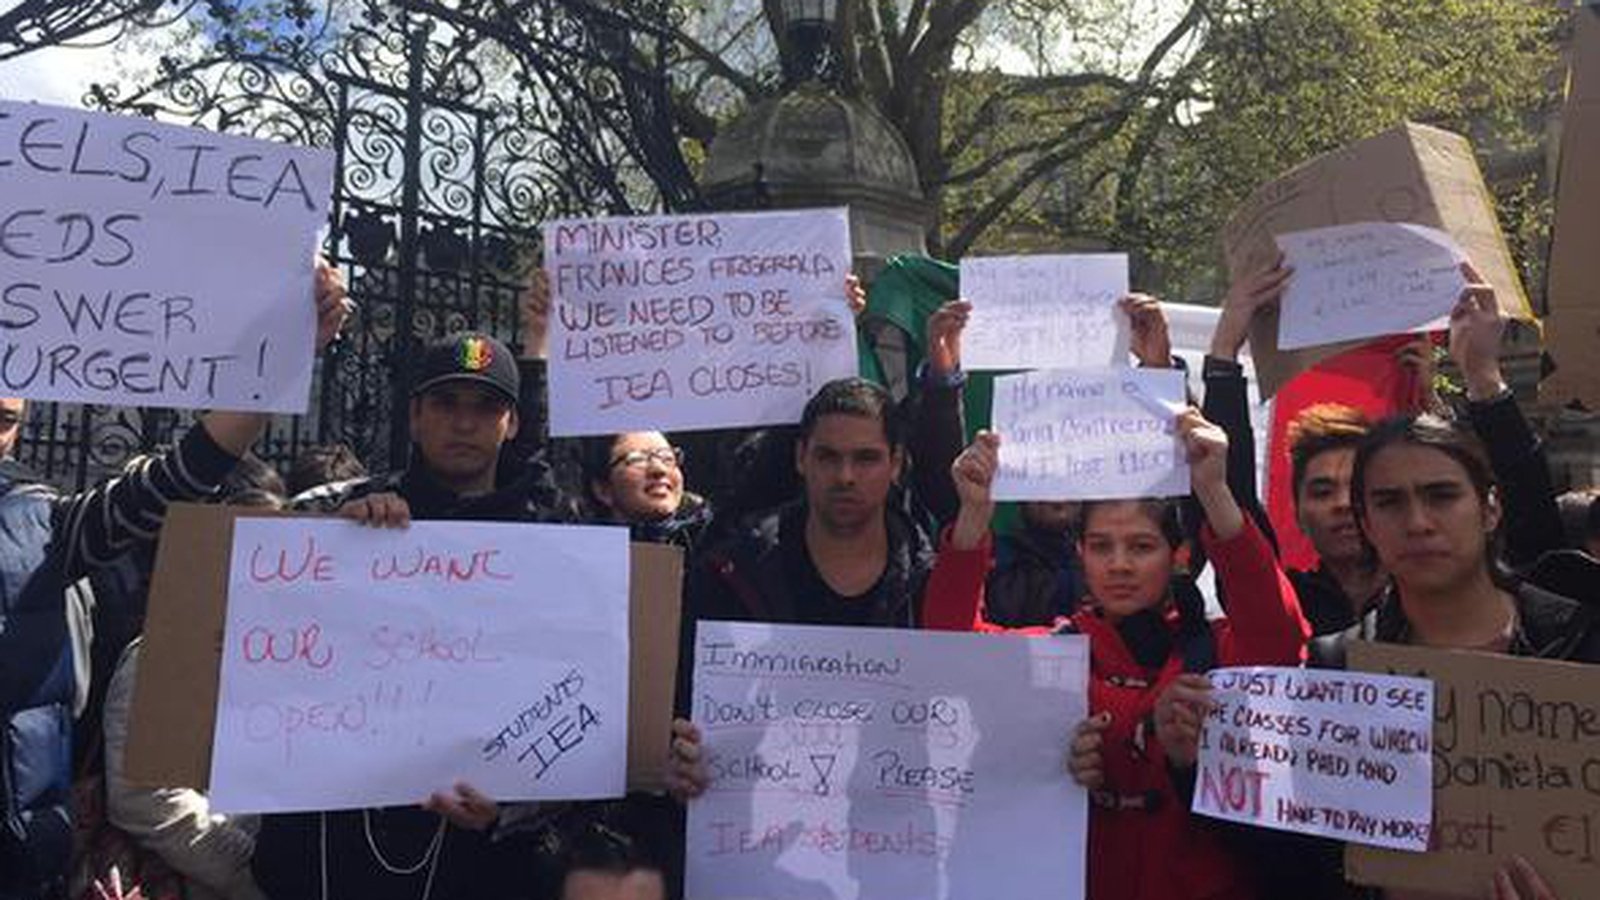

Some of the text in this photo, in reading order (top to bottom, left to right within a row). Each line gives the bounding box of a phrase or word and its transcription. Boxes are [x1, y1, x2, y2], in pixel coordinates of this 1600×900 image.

[557, 257, 695, 296] FRANCES
[0, 283, 197, 341] SWER
[559, 289, 794, 332] WE NEED TO BE
[564, 318, 842, 361] LISTENED TO BEFORE
[595, 368, 674, 410] IEA
[250, 533, 515, 582] WE WANT
[242, 624, 504, 670] OUR SCHOOL
[891, 699, 958, 727] OUR
[1222, 672, 1277, 697] JUST
[1285, 675, 1345, 703] WANT
[1352, 681, 1378, 705] TO
[1386, 688, 1426, 711] SEE
[1208, 703, 1226, 724] HE
[1233, 705, 1312, 736] CLASSES
[1318, 720, 1360, 746] FOR
[1478, 688, 1600, 742] name
[712, 757, 800, 783] SCHOOL
[870, 748, 975, 793] PLEASE
[1219, 732, 1298, 766] ALREADY
[1306, 751, 1349, 778] PAID
[1356, 761, 1398, 785] AND
[1201, 759, 1271, 816] NOT
[1277, 797, 1320, 826] HAVE
[1321, 807, 1345, 831] TO
[1348, 808, 1377, 836] PAY
